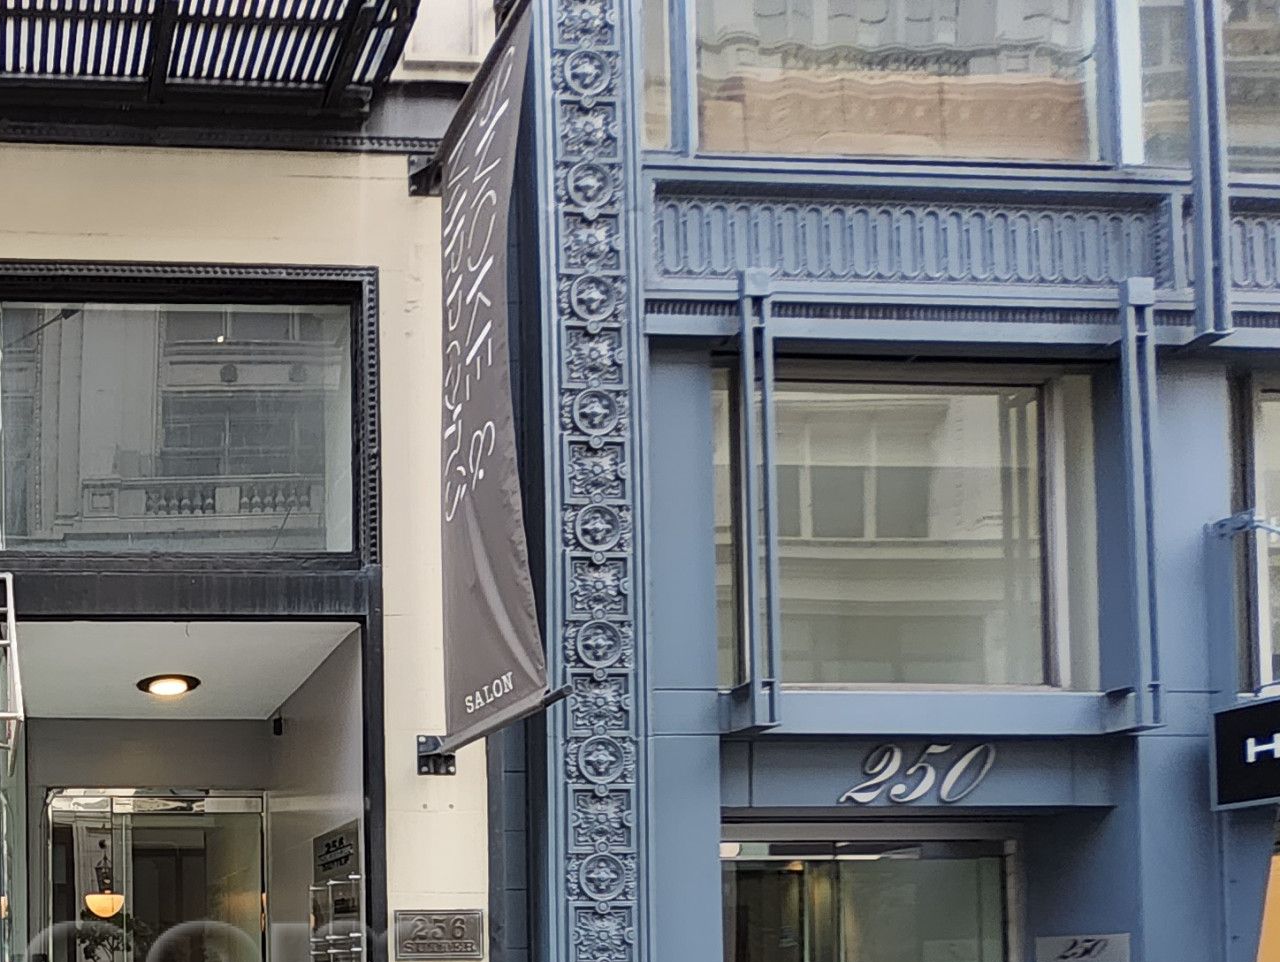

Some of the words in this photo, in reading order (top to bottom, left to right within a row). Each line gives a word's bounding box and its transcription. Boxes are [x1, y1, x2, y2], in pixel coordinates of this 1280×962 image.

[468, 420, 496, 491] &
[464, 671, 514, 714] SALON
[837, 743, 996, 804] 250
[410, 915, 467, 940] 256
[1056, 938, 1109, 960] 250
